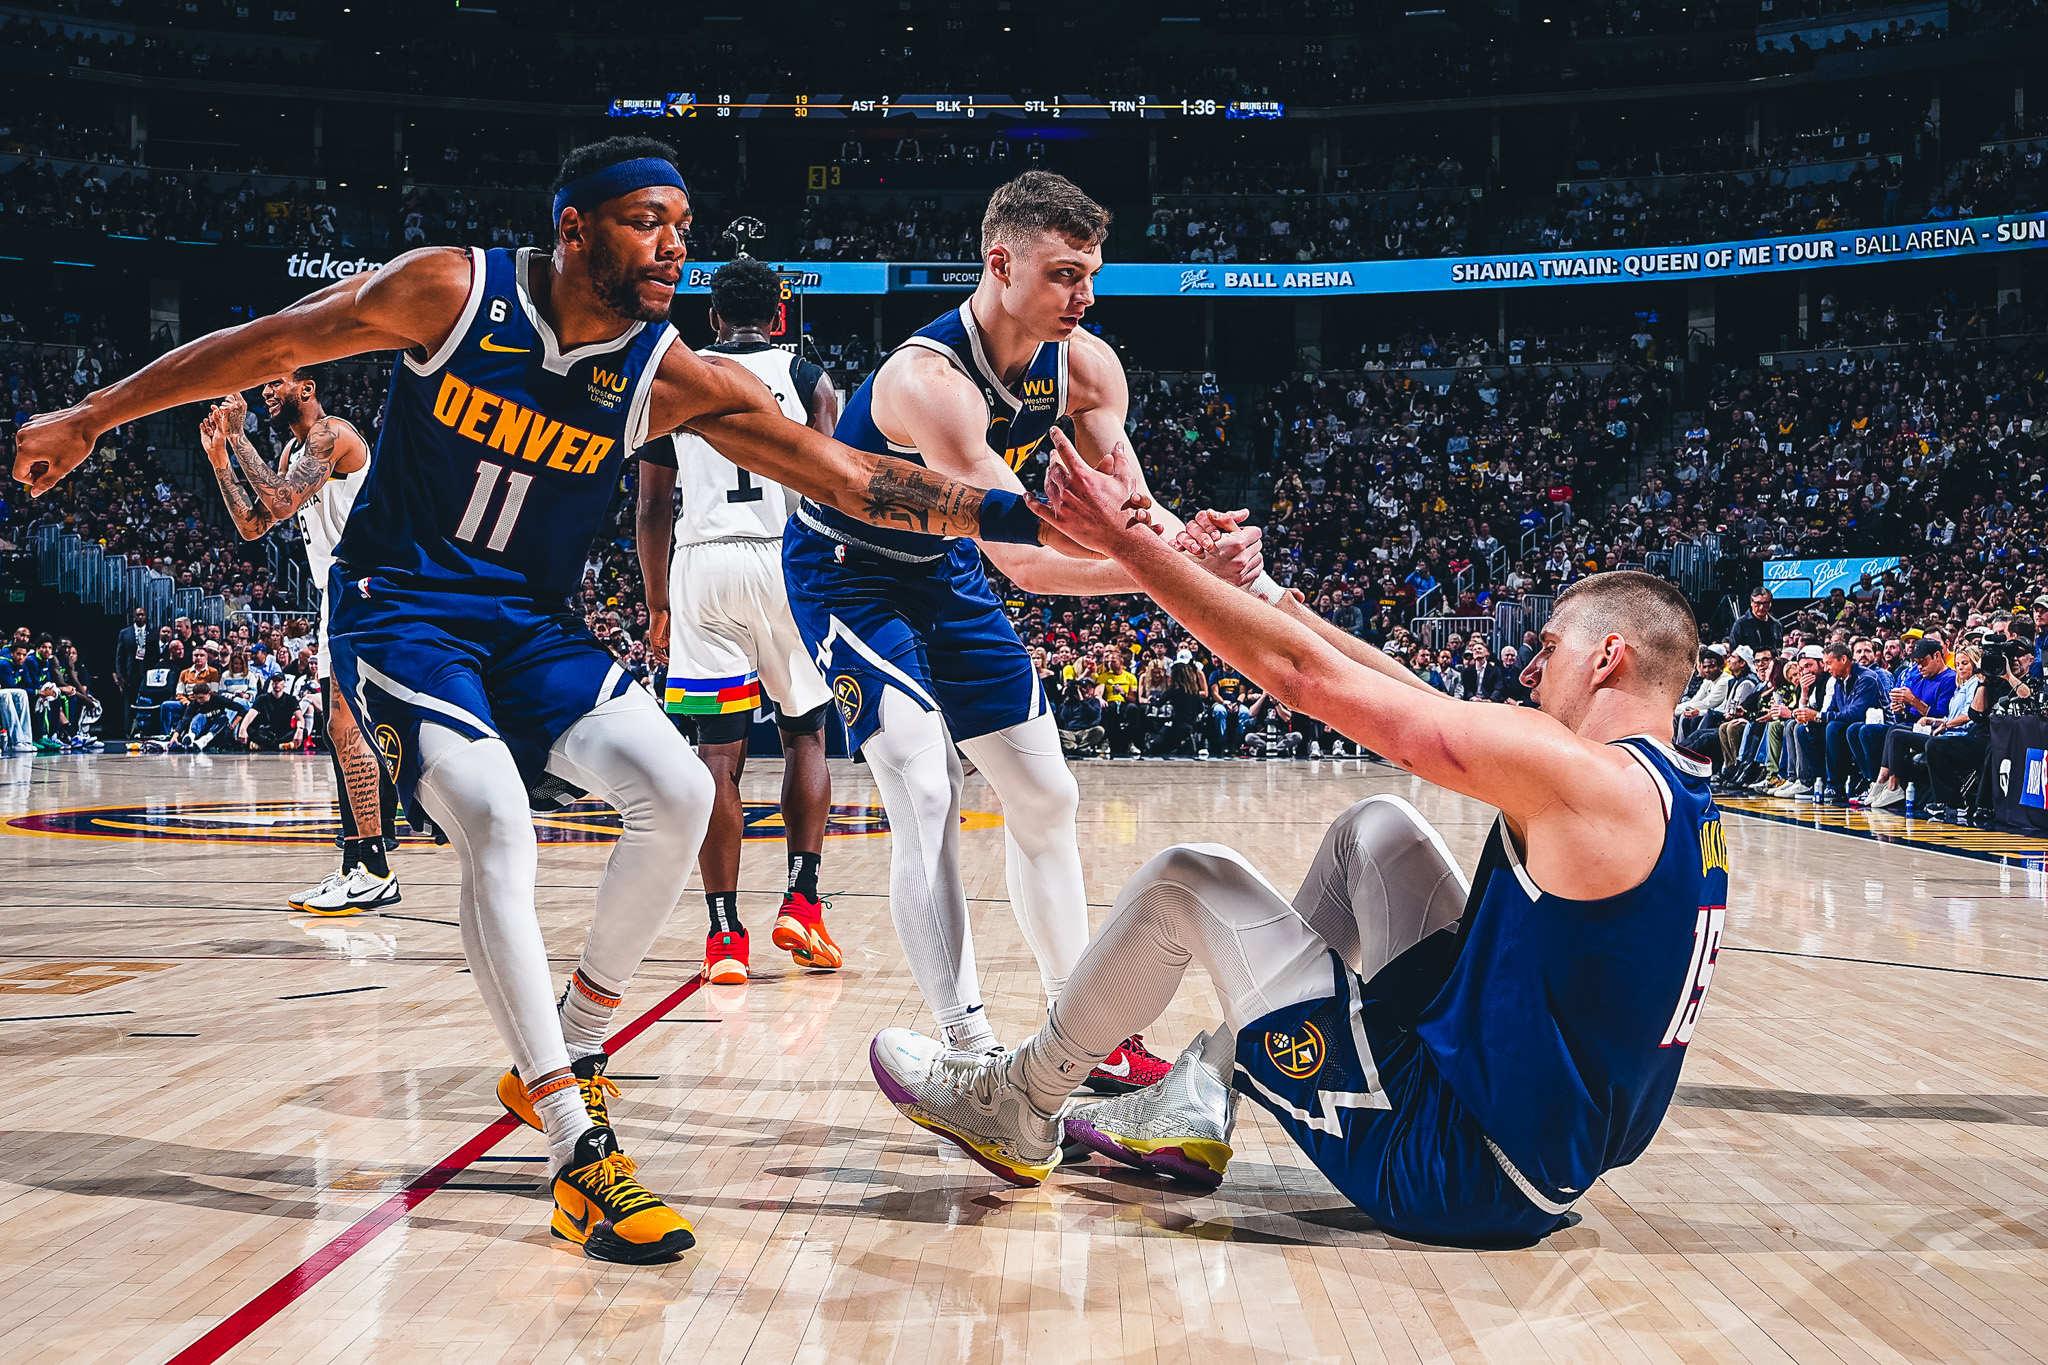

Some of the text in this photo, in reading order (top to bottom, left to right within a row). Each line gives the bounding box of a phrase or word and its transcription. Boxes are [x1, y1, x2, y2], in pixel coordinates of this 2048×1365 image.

[717, 95, 730, 104] 19
[795, 95, 808, 104] 19
[882, 96, 889, 105] 2
[967, 96, 973, 104] 1
[1053, 96, 1059, 104] 1
[1139, 96, 1146, 105] 3
[852, 101, 875, 112] AST
[936, 101, 961, 112] BLK
[1025, 101, 1048, 112] STL
[1109, 101, 1136, 112] TRN
[1181, 99, 1216, 115] 1:36
[717, 108, 730, 117] 30
[795, 108, 808, 117] 30
[882, 108, 889, 118] 7
[967, 108, 974, 118] 0
[1053, 108, 1060, 118] 2
[1139, 109, 1144, 118] 1
[1452, 263, 1535, 282] SHANIA
[1540, 257, 1618, 277] TWAIN:
[1624, 252, 1698, 275] QUEEN
[1704, 249, 1732, 268] OF
[1738, 246, 1770, 265] ME
[1775, 241, 1834, 262] TOUR
[1855, 234, 1901, 255] BALL
[1906, 227, 1975, 249] ARENA
[1997, 220, 2046, 242] SUN
[1224, 271, 1353, 288] BALL ARENA
[490, 299, 507, 323] 6
[593, 366, 628, 393] WU
[1023, 379, 1054, 397] WU
[587, 384, 622, 404] Western
[590, 393, 614, 409] Union
[1024, 397, 1055, 406] Western
[1029, 404, 1051, 412] Union
[433, 371, 615, 475] DENVER
[455, 460, 534, 552] 11
[1768, 561, 1802, 588] Ball
[1813, 559, 1848, 588] Ball
[1658, 905, 1727, 1048] 15
